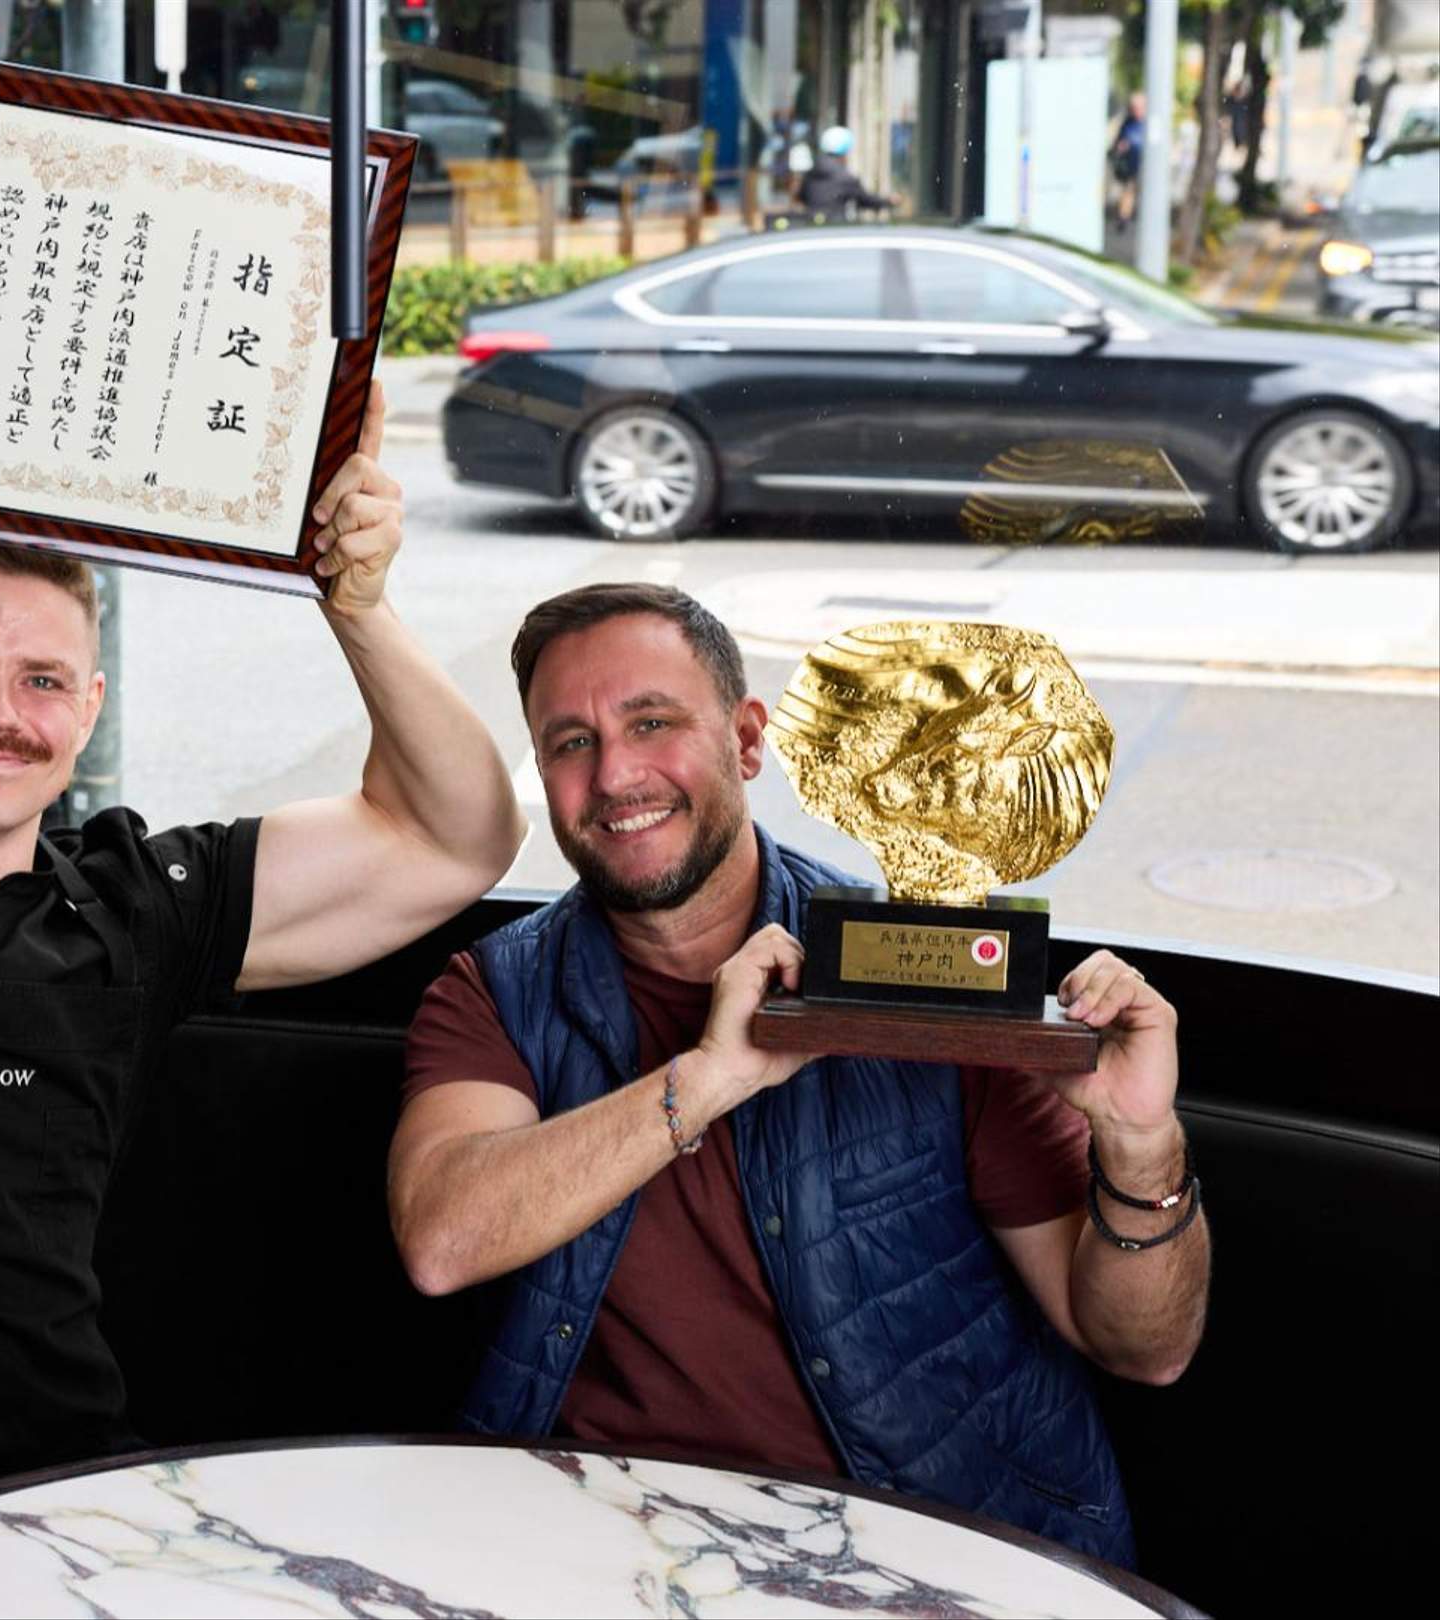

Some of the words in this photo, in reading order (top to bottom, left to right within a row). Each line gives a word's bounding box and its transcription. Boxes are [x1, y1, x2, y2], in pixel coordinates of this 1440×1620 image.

[206, 253, 273, 434] 指定証
[896, 949, 954, 970] 神戸肉
